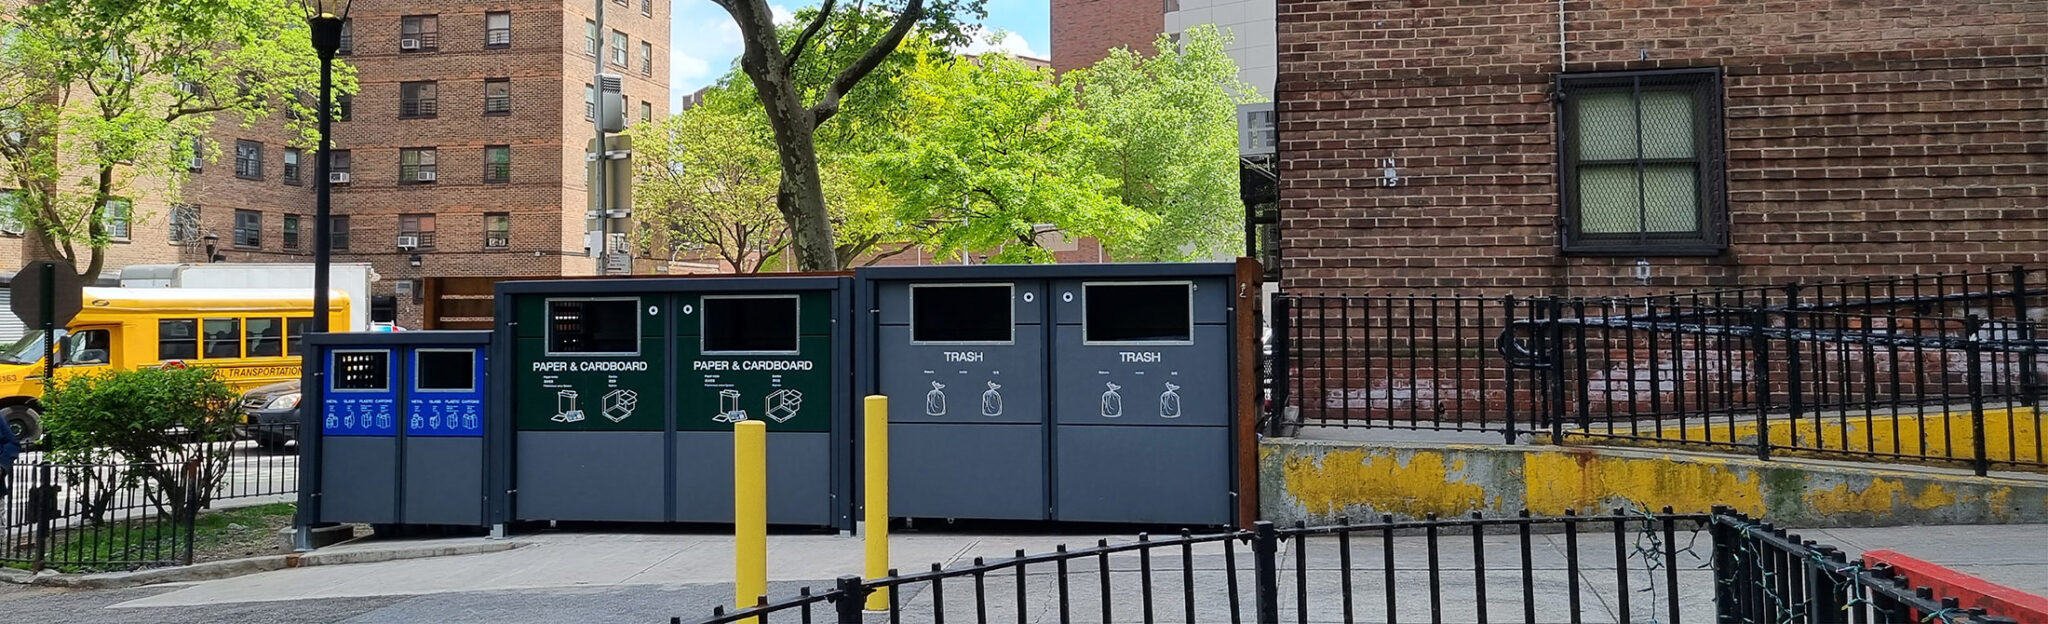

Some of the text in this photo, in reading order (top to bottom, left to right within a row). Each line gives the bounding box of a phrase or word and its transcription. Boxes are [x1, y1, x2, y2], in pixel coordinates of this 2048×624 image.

[944, 352, 984, 362] TRASH
[1119, 352, 1161, 362] TRASH
[532, 362, 648, 372] PAPER & CARDBOARD
[694, 360, 813, 370] PAPER & CARDBOARD
